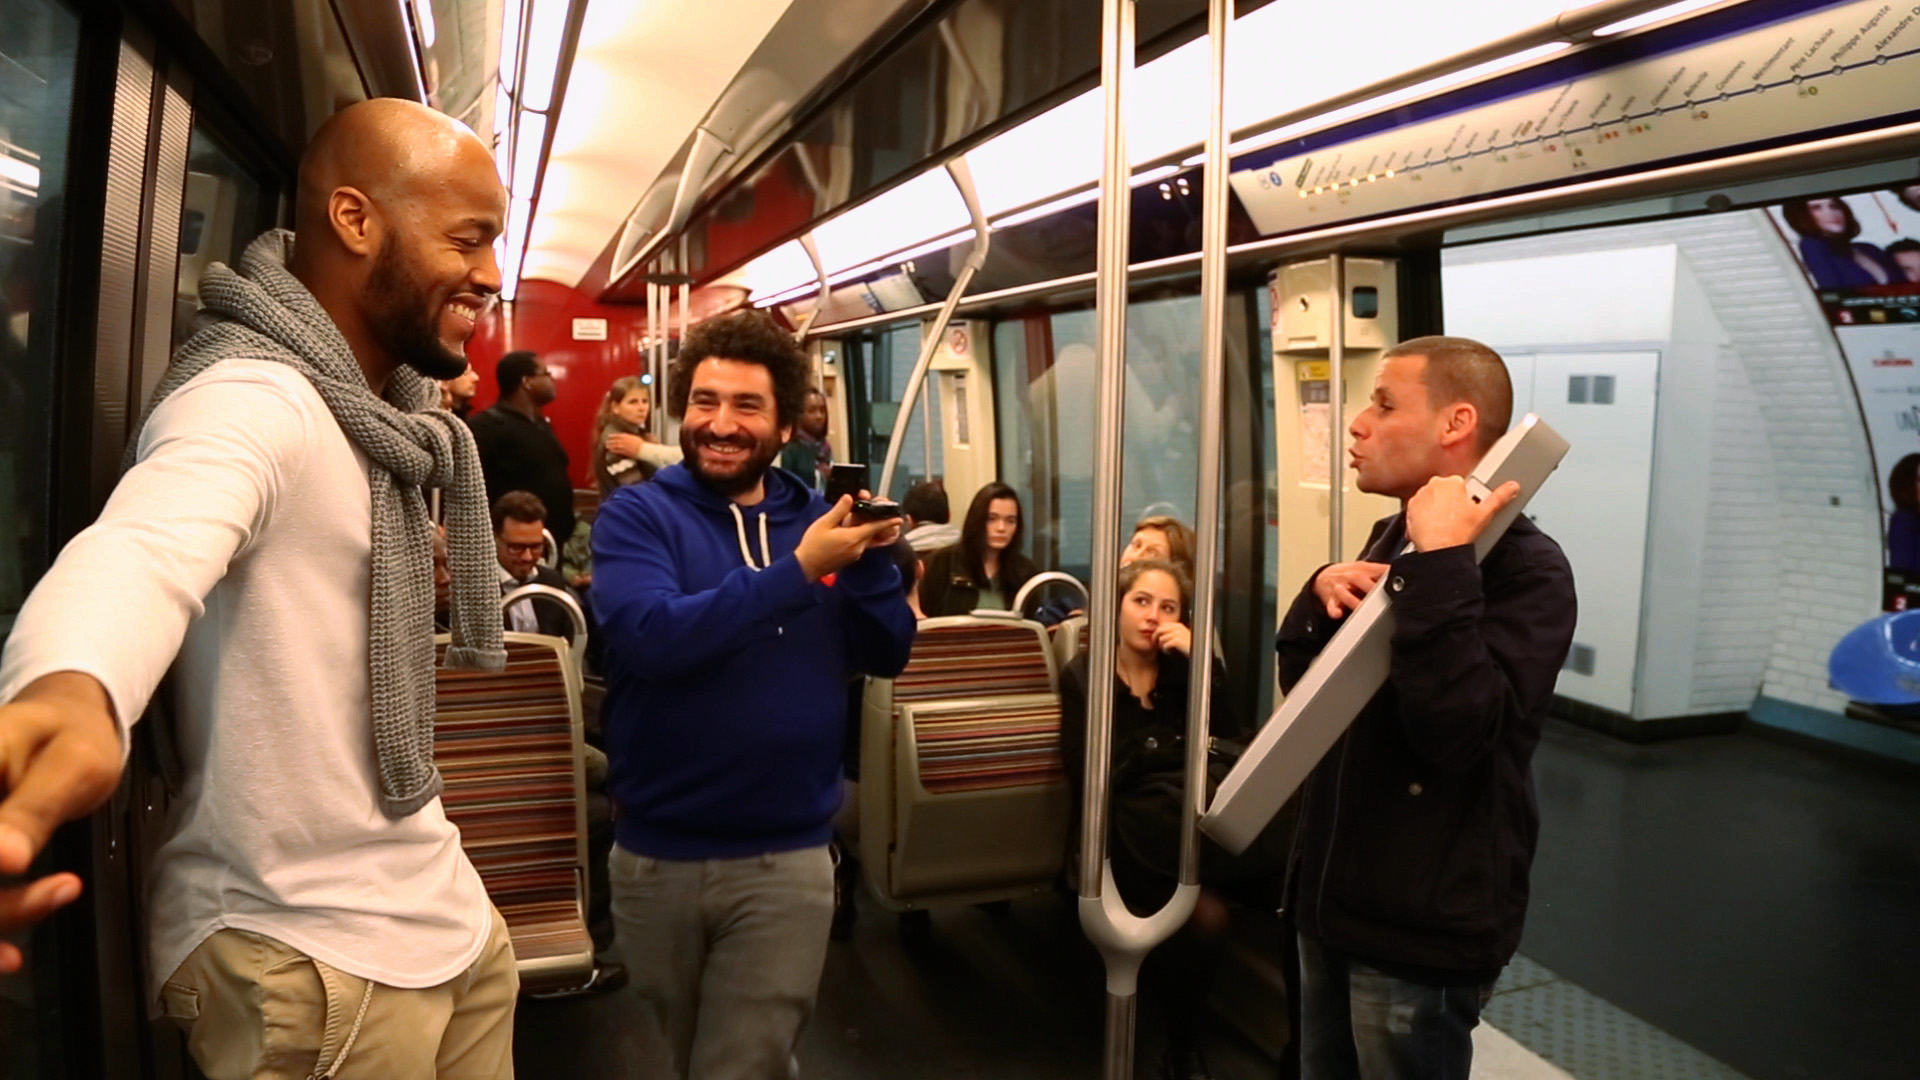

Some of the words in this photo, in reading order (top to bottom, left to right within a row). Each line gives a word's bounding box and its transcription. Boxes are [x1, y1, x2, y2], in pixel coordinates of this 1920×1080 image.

[1830, 34, 1860, 62] Philippe
[1859, 5, 1890, 35] Auguste
[1875, 15, 1914, 51] Alexandre
